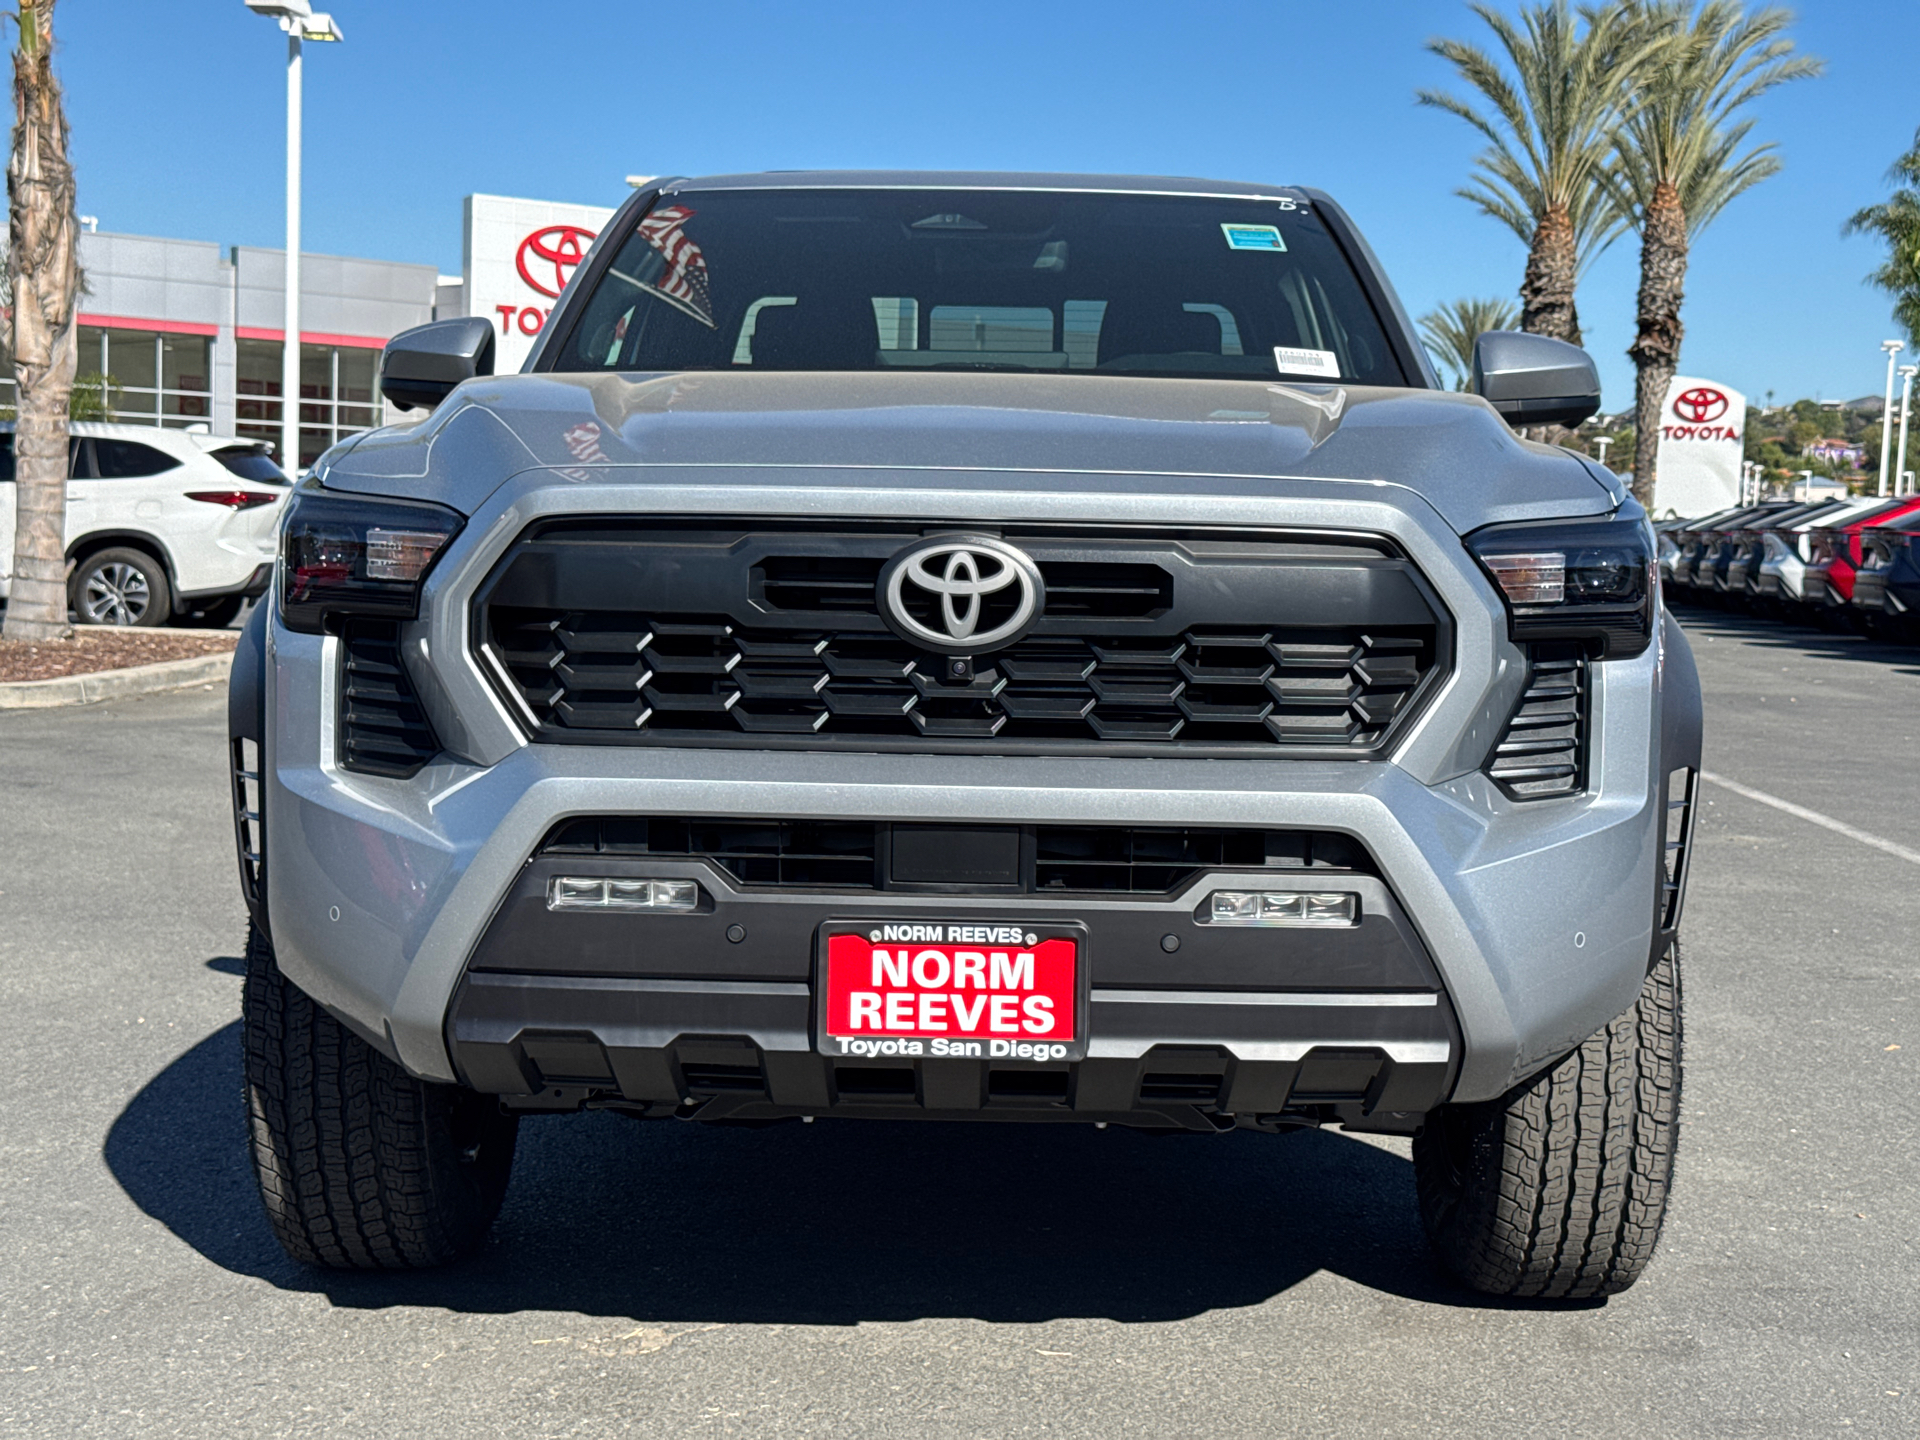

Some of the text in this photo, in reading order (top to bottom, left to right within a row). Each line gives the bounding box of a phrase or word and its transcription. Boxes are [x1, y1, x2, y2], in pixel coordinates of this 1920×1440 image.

[496, 305, 552, 336] TO
[1663, 426, 1738, 440] TOYOTA
[883, 925, 1023, 944] NORM REEVES
[872, 949, 1035, 990] NORM
[849, 991, 1056, 1034] REEVES
[836, 1036, 1068, 1062] Toyota San Diego
